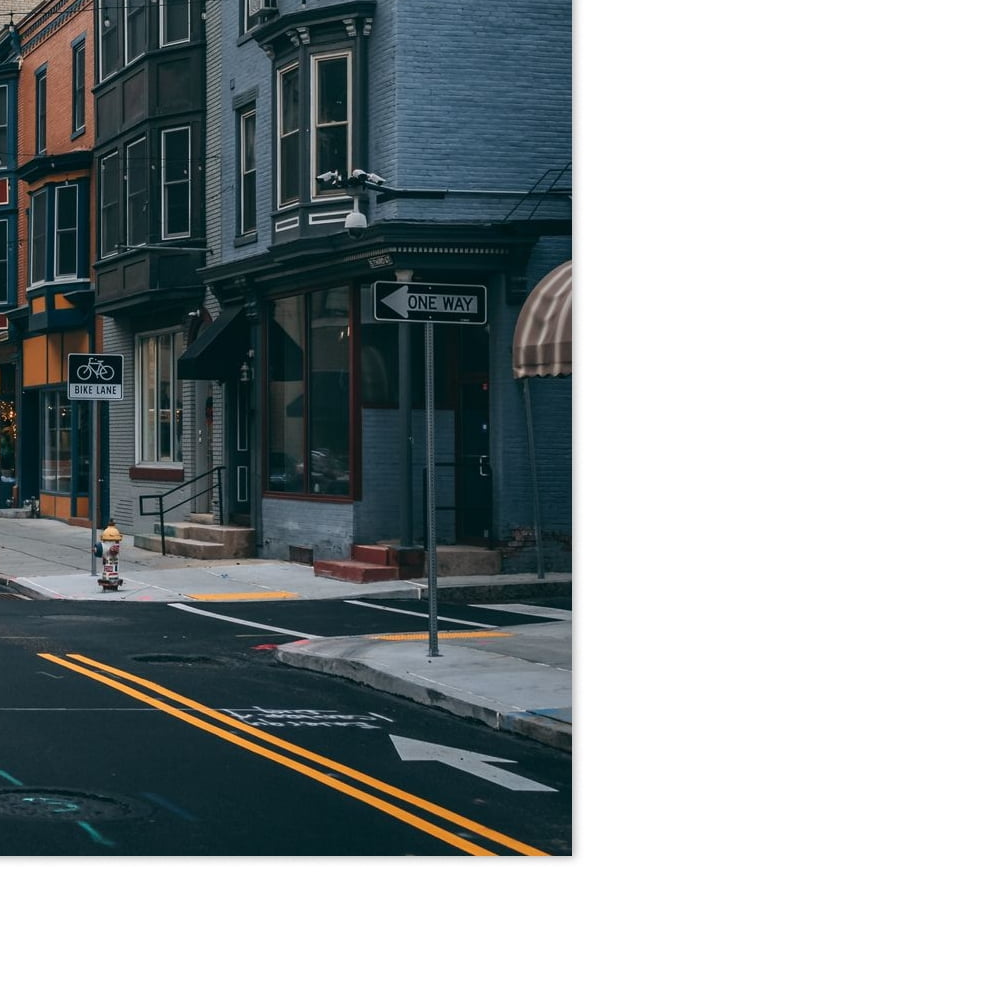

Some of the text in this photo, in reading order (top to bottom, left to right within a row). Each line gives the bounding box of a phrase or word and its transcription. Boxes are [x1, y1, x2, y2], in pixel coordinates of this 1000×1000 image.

[407, 295, 473, 311] ONE WAY
[74, 385, 117, 394] BIKE LANE
